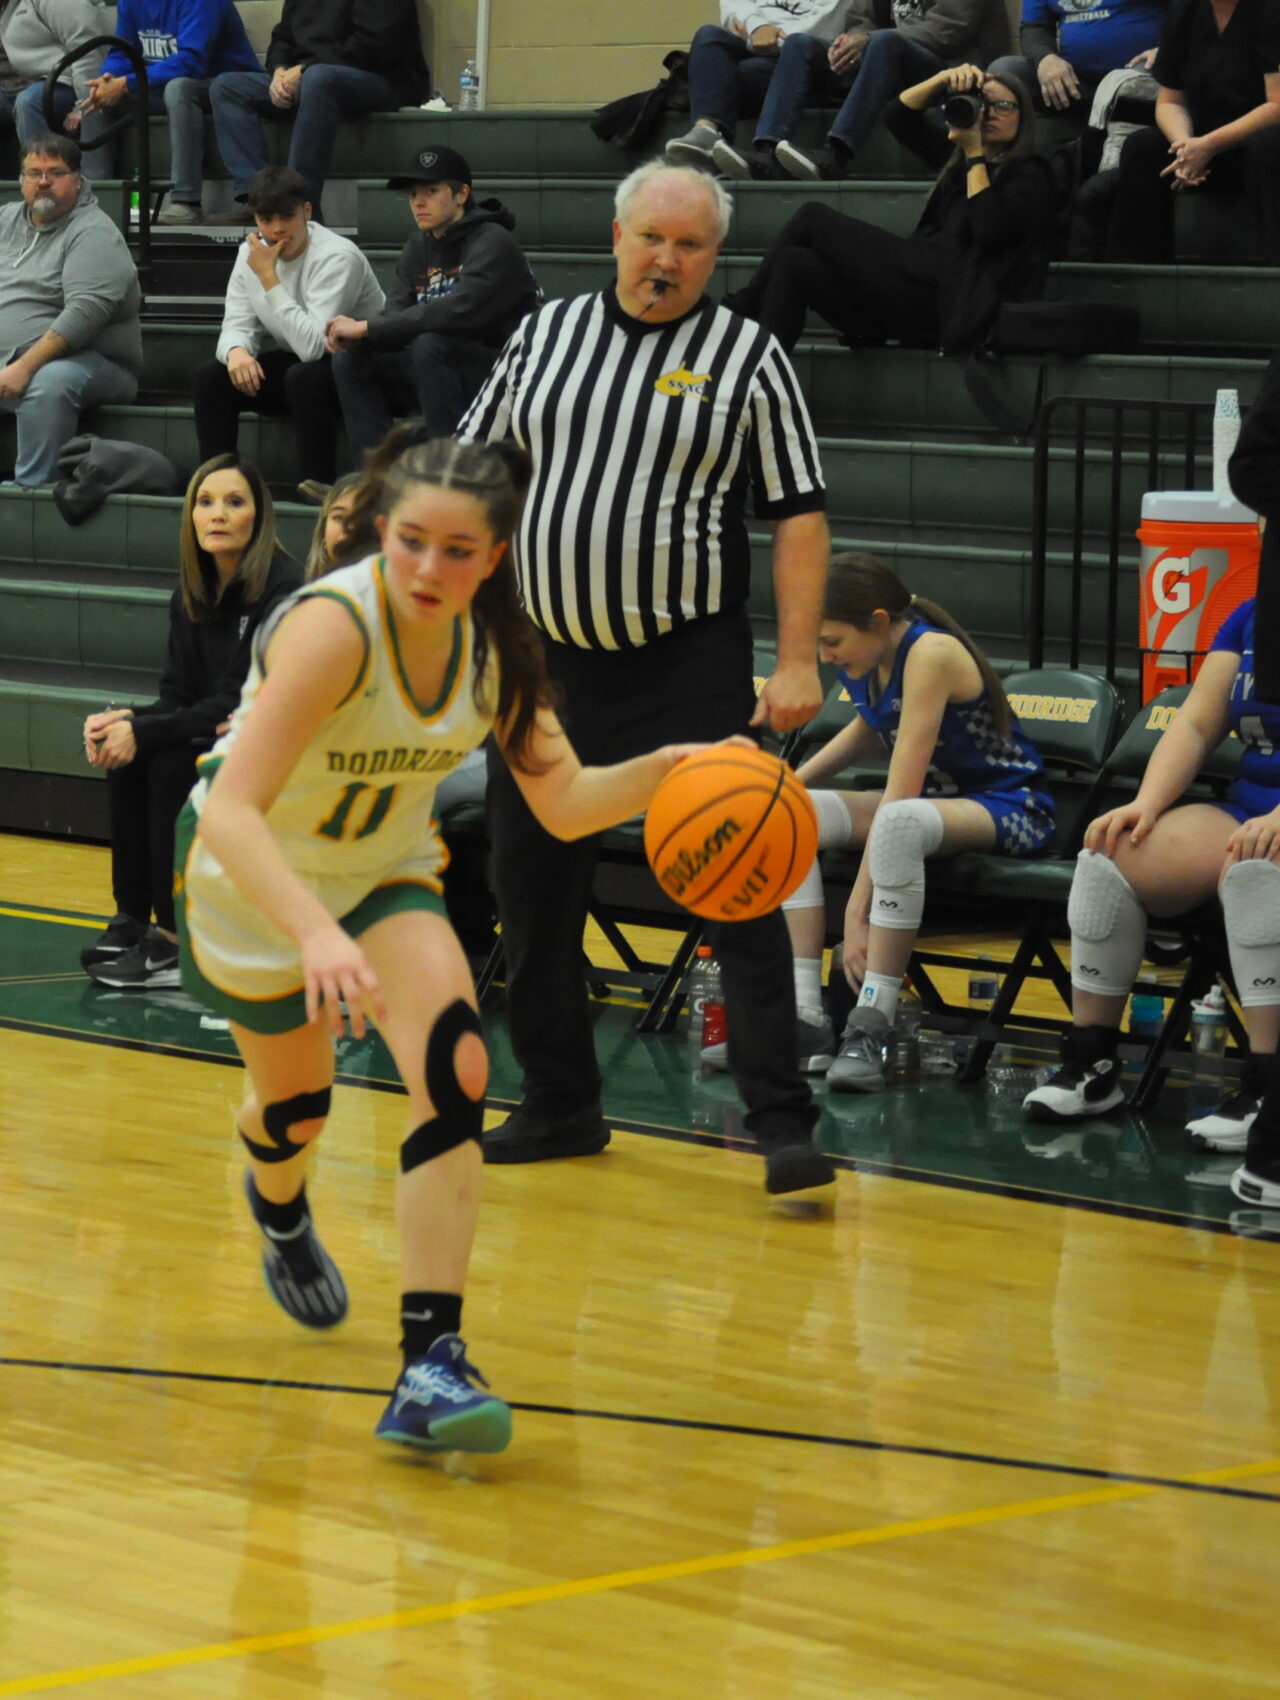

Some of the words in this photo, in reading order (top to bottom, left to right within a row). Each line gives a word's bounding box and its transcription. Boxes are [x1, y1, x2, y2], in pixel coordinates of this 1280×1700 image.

[667, 379, 706, 395] SSAC
[1152, 556, 1191, 614] G
[1006, 693, 1097, 723] ODDRIDGE
[312, 780, 398, 842] 11
[661, 817, 742, 897] Wilson
